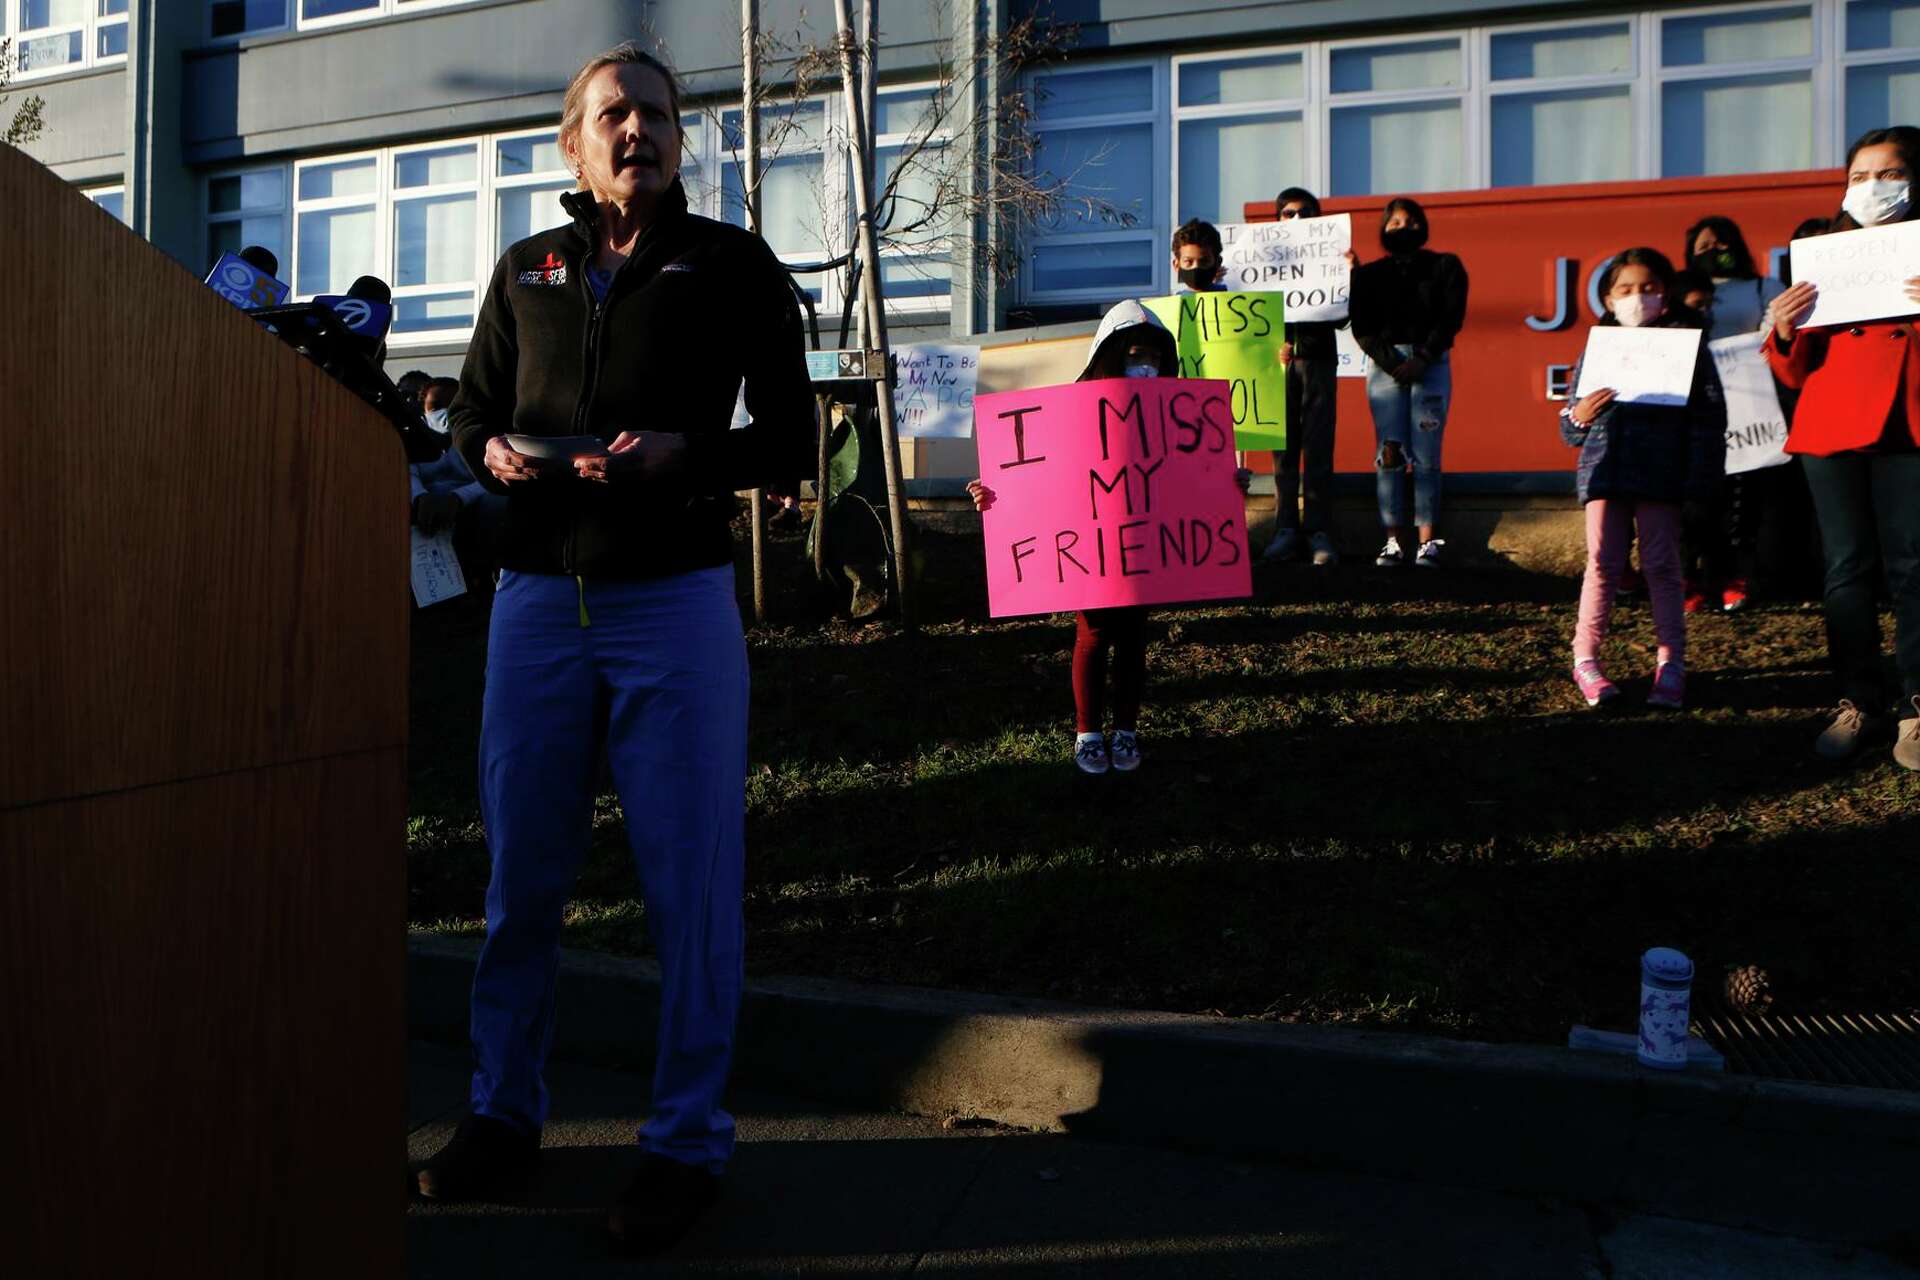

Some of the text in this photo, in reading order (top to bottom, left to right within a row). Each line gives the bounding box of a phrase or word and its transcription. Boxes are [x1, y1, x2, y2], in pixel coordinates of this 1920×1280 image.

[1225, 222, 1337, 245] I MISS MY
[1232, 241, 1344, 265] CLASSMATES
[1240, 263, 1345, 284] OPEN THE
[1285, 285, 1349, 308] OOLS
[1177, 294, 1272, 342] MISS
[936, 355, 954, 368] To
[909, 369, 928, 393] My
[997, 391, 1227, 470] I MISS
[1089, 457, 1165, 520] MY
[1011, 519, 1241, 583] FRIENDS
